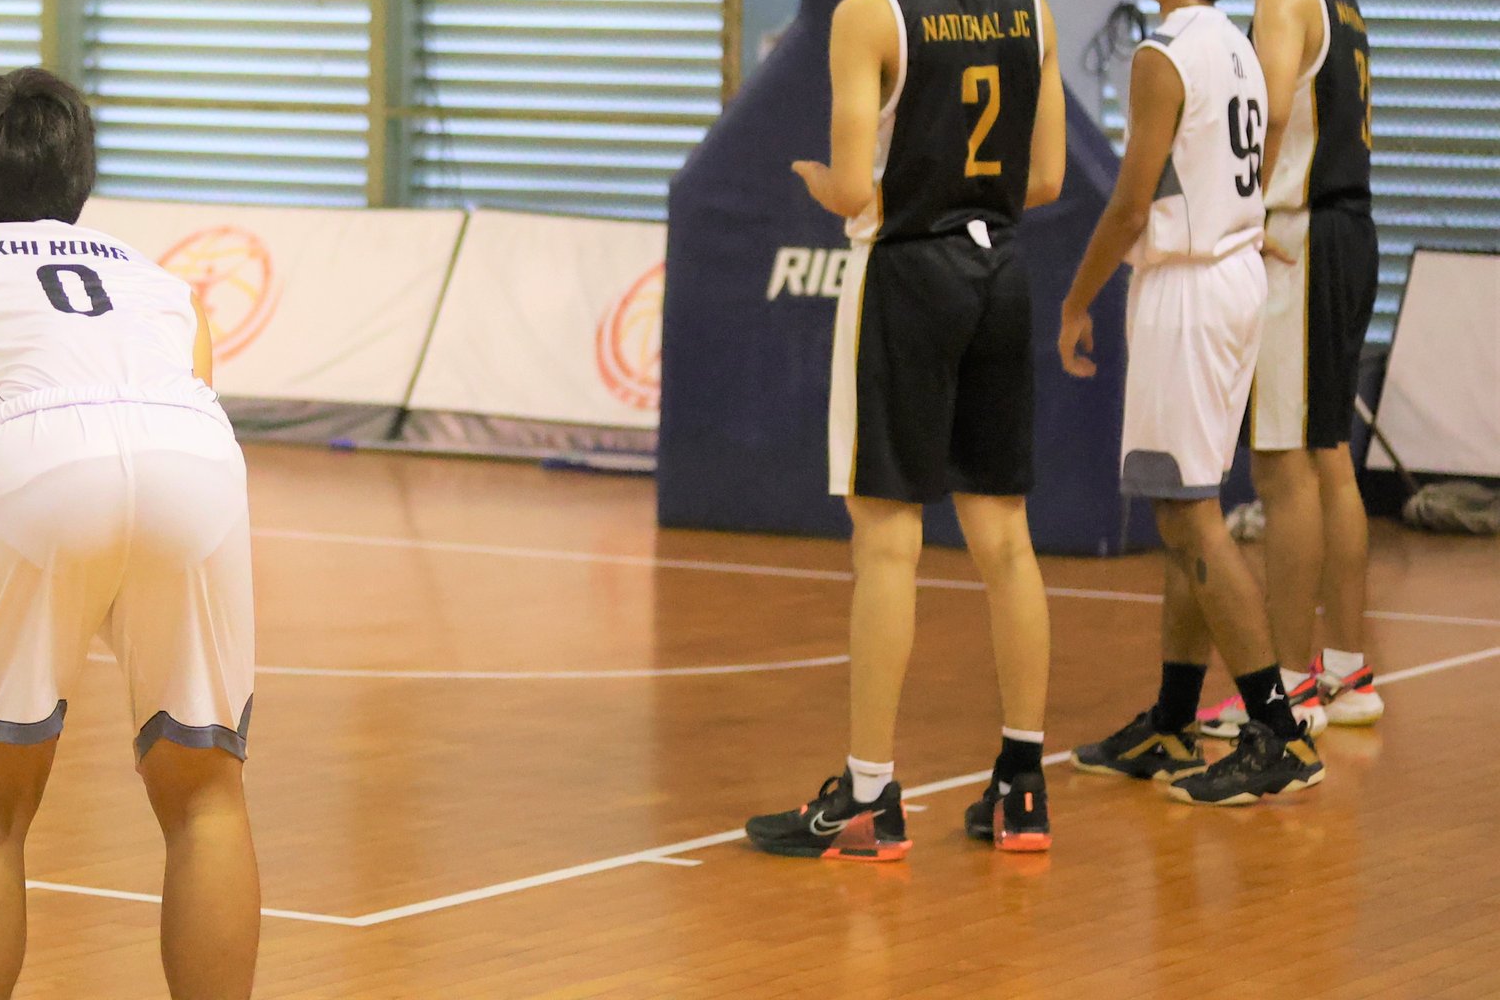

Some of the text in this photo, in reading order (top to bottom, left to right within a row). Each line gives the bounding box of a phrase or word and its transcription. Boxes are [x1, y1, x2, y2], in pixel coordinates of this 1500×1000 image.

[921, 10, 1030, 42] NATIONAL JC
[961, 65, 1001, 177] 2
[36, 264, 113, 317] 0
